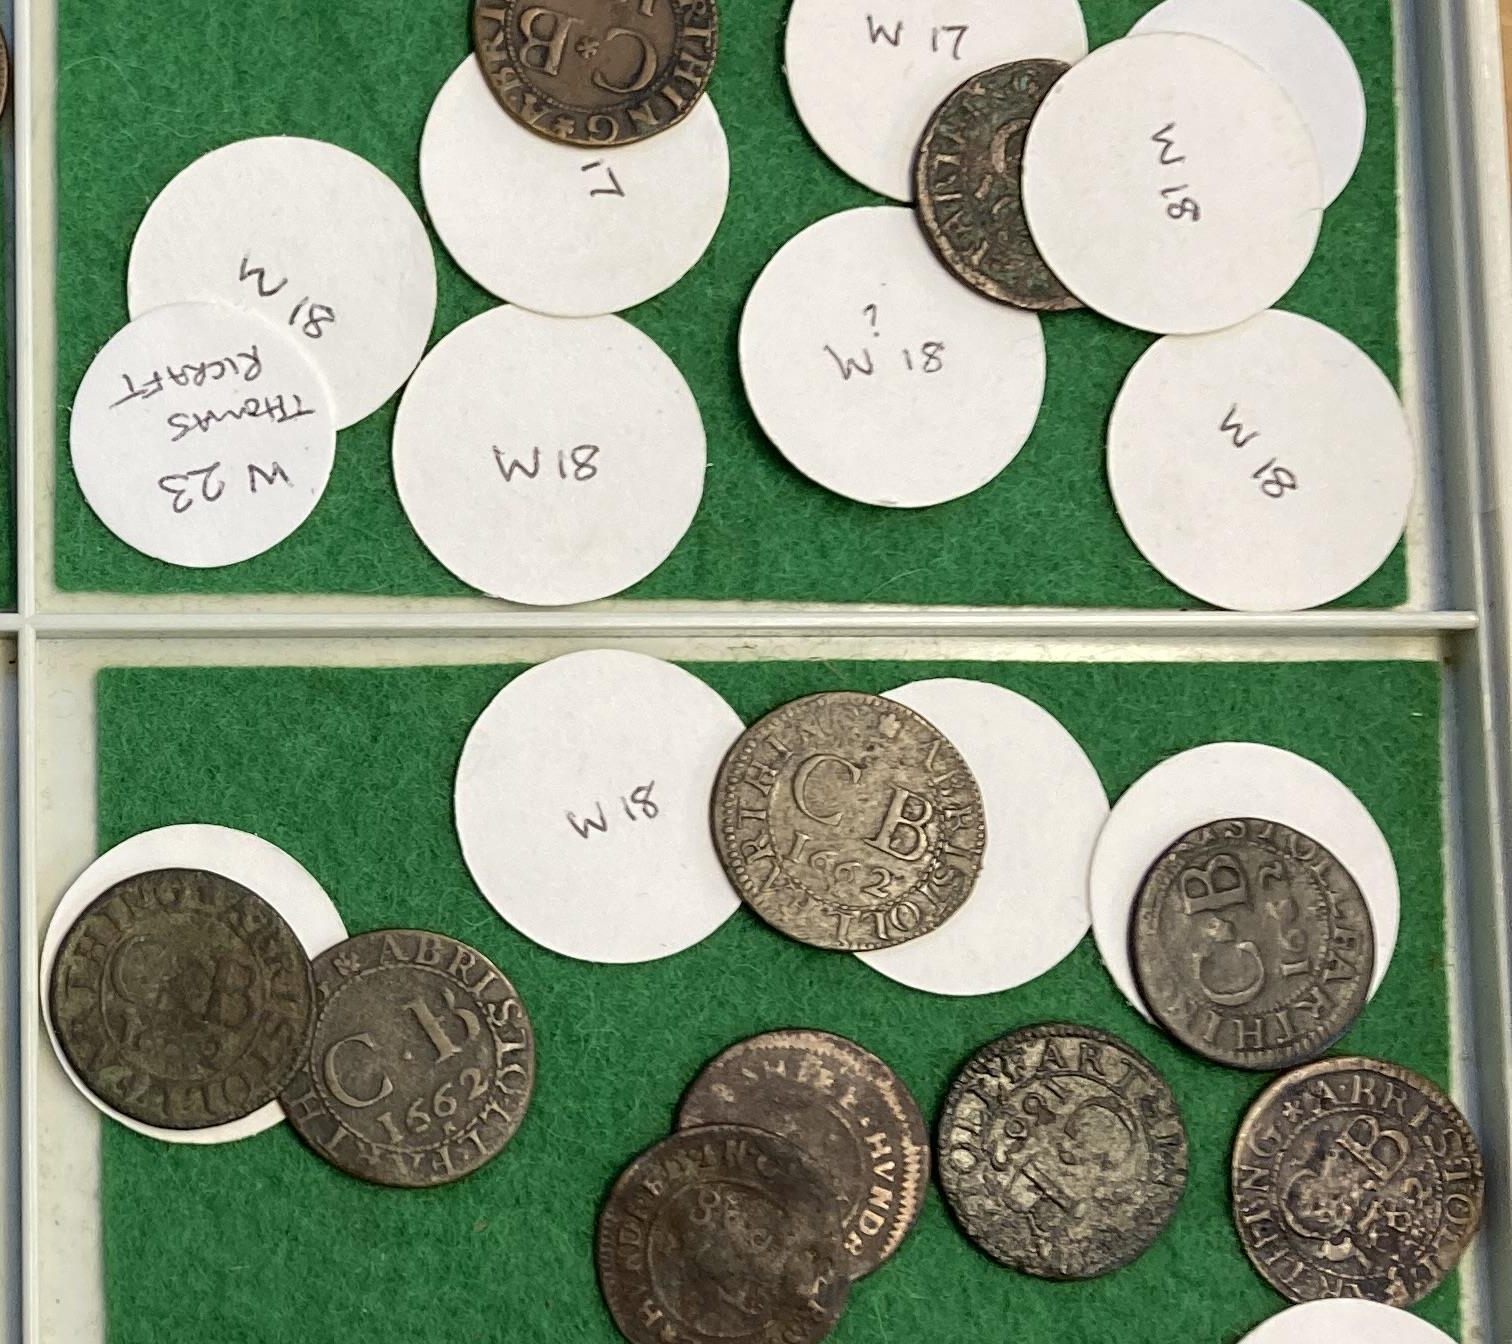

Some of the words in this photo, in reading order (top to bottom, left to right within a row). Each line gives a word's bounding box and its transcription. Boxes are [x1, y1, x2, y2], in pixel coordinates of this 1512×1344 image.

[865, 14, 904, 48] W
[931, 24, 970, 61] 17
[1151, 122, 1186, 166] W
[1159, 183, 1201, 223] 18
[238, 256, 289, 298] W
[287, 295, 336, 340] 18
[823, 344, 874, 381] W
[902, 341, 946, 374] 18
[166, 394, 316, 443] THOMAS
[1218, 402, 1260, 449] W
[1251, 457, 1299, 499] 18
[157, 461, 226, 514] 23
[246, 461, 290, 494] W
[566, 801, 608, 840] W
[620, 780, 660, 822] 18
[841, 1131, 897, 1259] HVNDR
